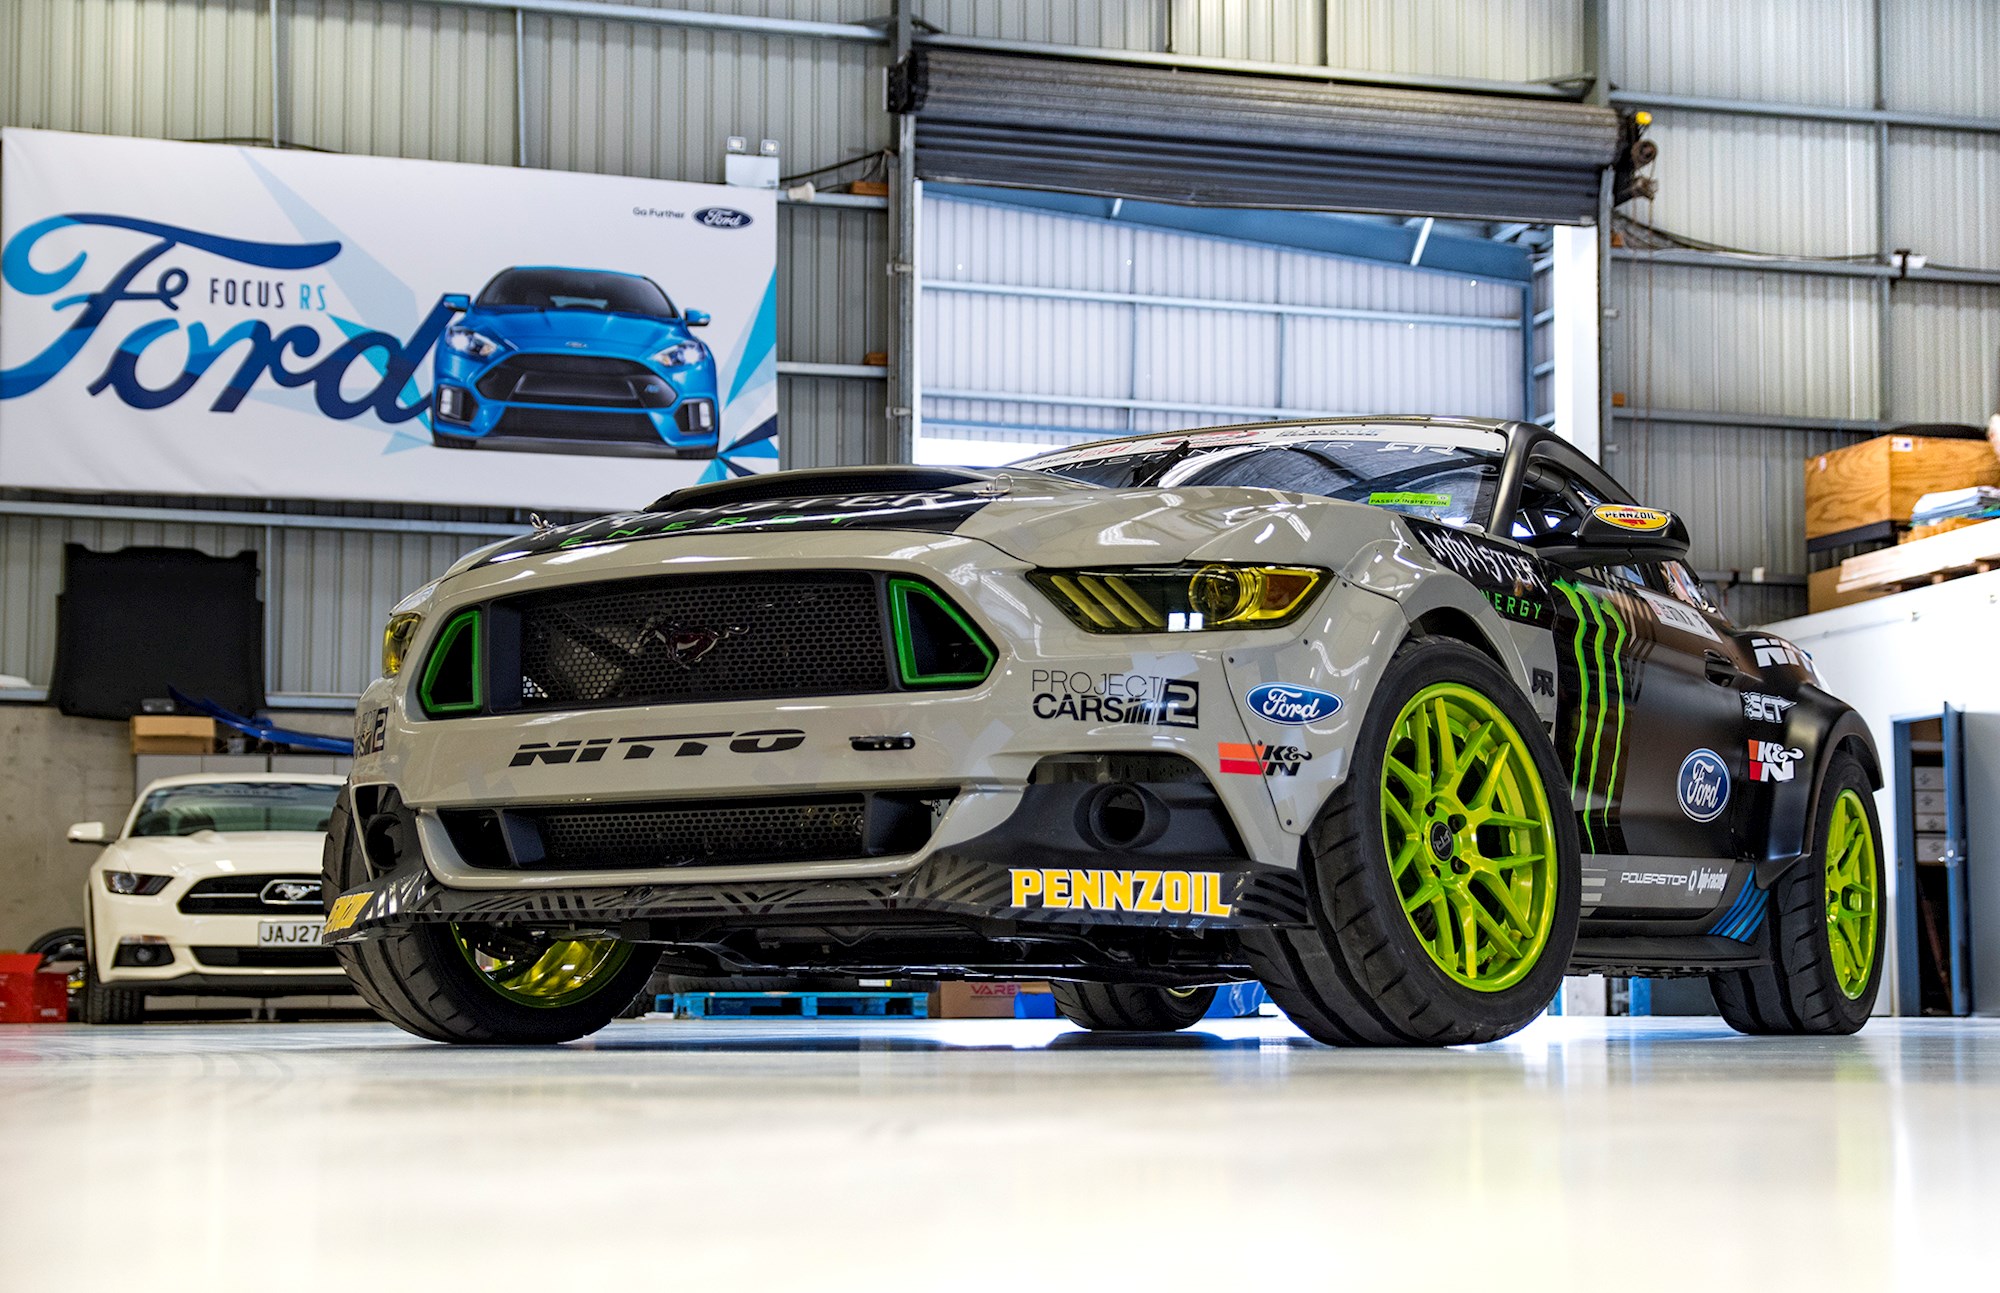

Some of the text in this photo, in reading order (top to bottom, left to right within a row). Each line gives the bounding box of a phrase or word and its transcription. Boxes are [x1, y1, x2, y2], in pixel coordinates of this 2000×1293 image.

[704, 207, 741, 226] Ford
[209, 278, 326, 311] FOCUS RS
[0, 212, 453, 424] Ford
[1043, 444, 1246, 473] MUSTN
[1605, 511, 1656, 520] PENNZOIL
[1418, 528, 1549, 595] MONSTER
[1032, 669, 1159, 698] PROJECT
[1032, 682, 1198, 727] CARS 2
[1262, 690, 1322, 719] Ford
[508, 728, 806, 768] NITTO
[1686, 759, 1722, 809] Ford
[1008, 868, 1233, 918] PENNZOIL
[1620, 872, 1688, 886] POWERSTOP
[261, 924, 324, 943] JAJ27
[970, 984, 1020, 995] VARE
